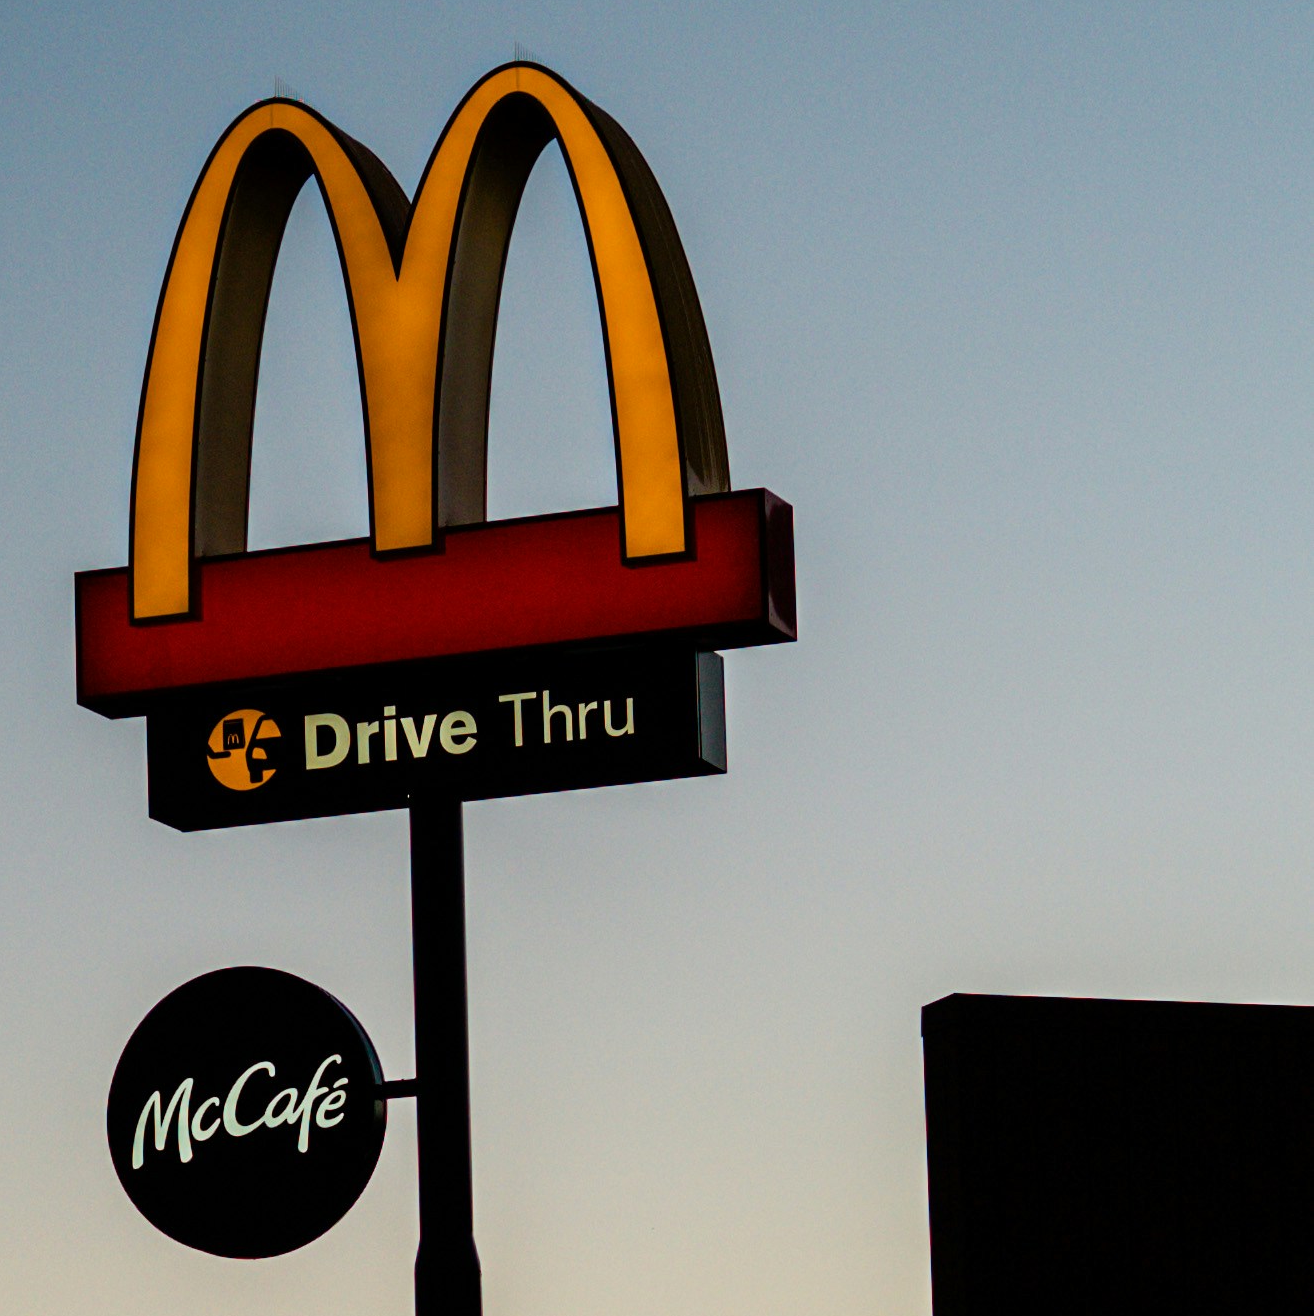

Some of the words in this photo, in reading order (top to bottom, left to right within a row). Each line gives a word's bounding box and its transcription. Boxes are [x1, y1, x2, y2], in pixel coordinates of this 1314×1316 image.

[304, 705, 478, 771] Drive
[498, 689, 636, 749] Thru
[131, 1053, 350, 1170] McCafé
